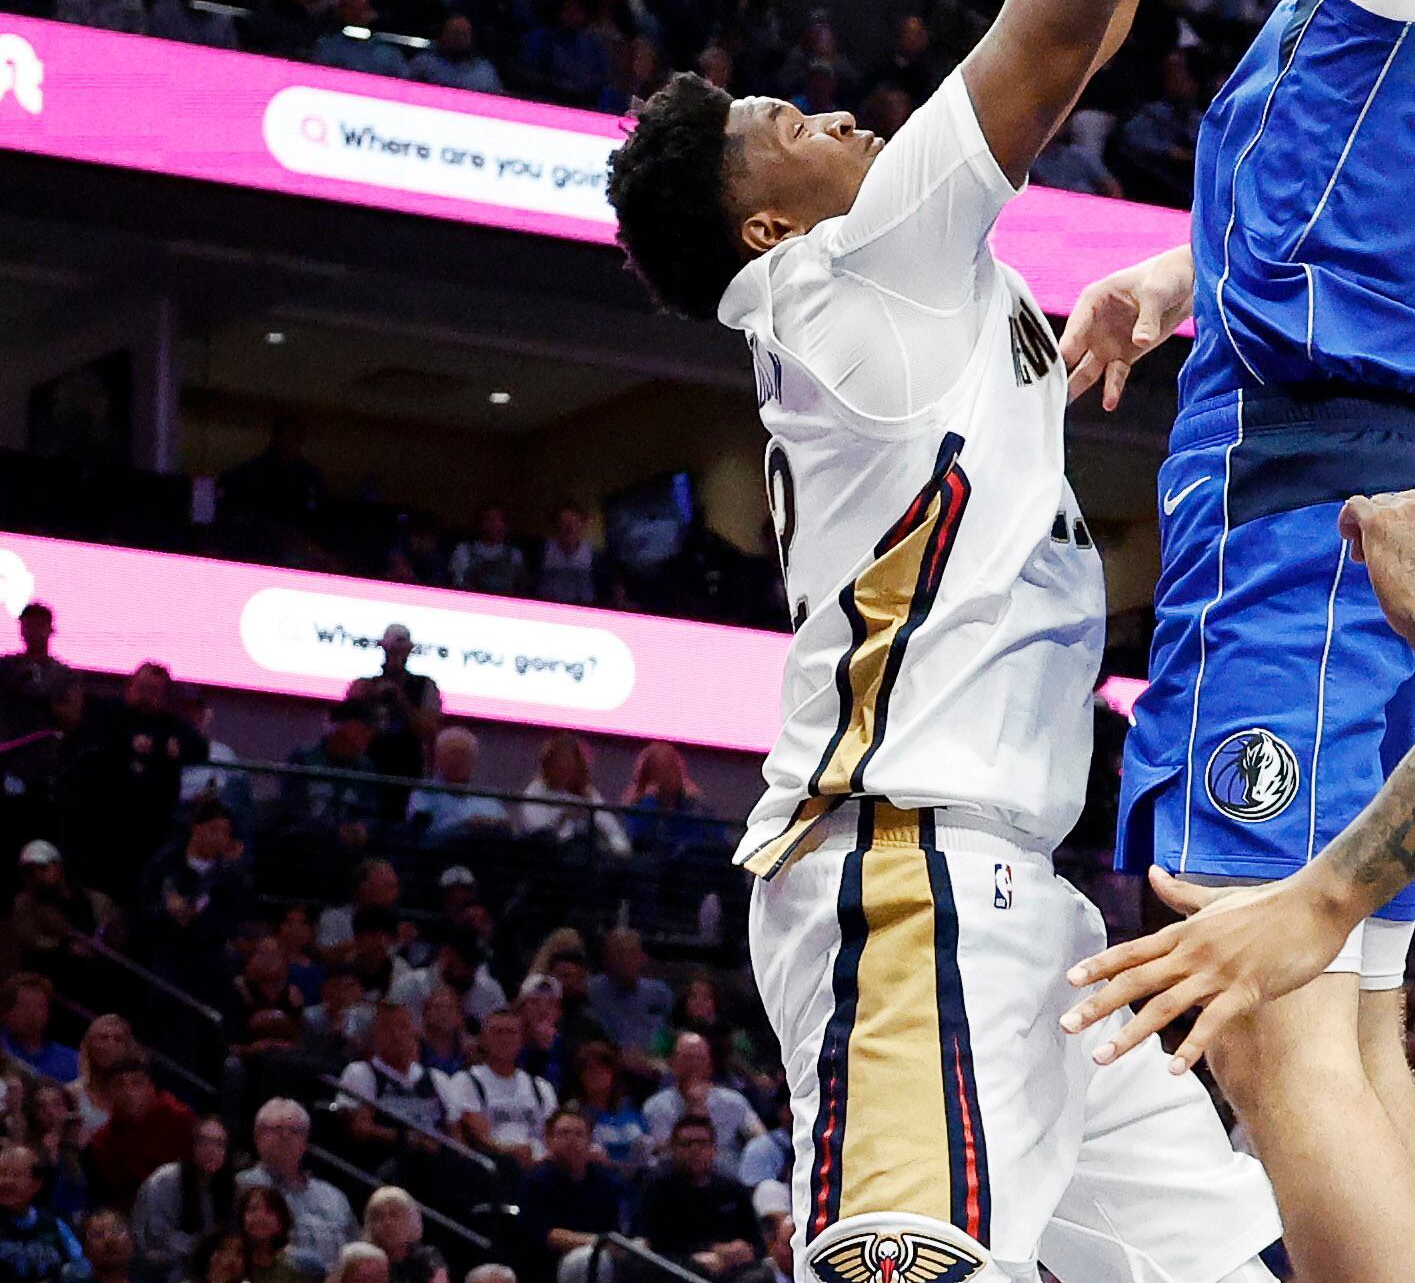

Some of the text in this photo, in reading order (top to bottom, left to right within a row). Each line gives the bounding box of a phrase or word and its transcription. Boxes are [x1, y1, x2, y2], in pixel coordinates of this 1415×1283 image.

[341, 122, 431, 159] Where
[440, 146, 485, 168] are
[496, 155, 542, 181] you
[514, 654, 598, 682] going?
